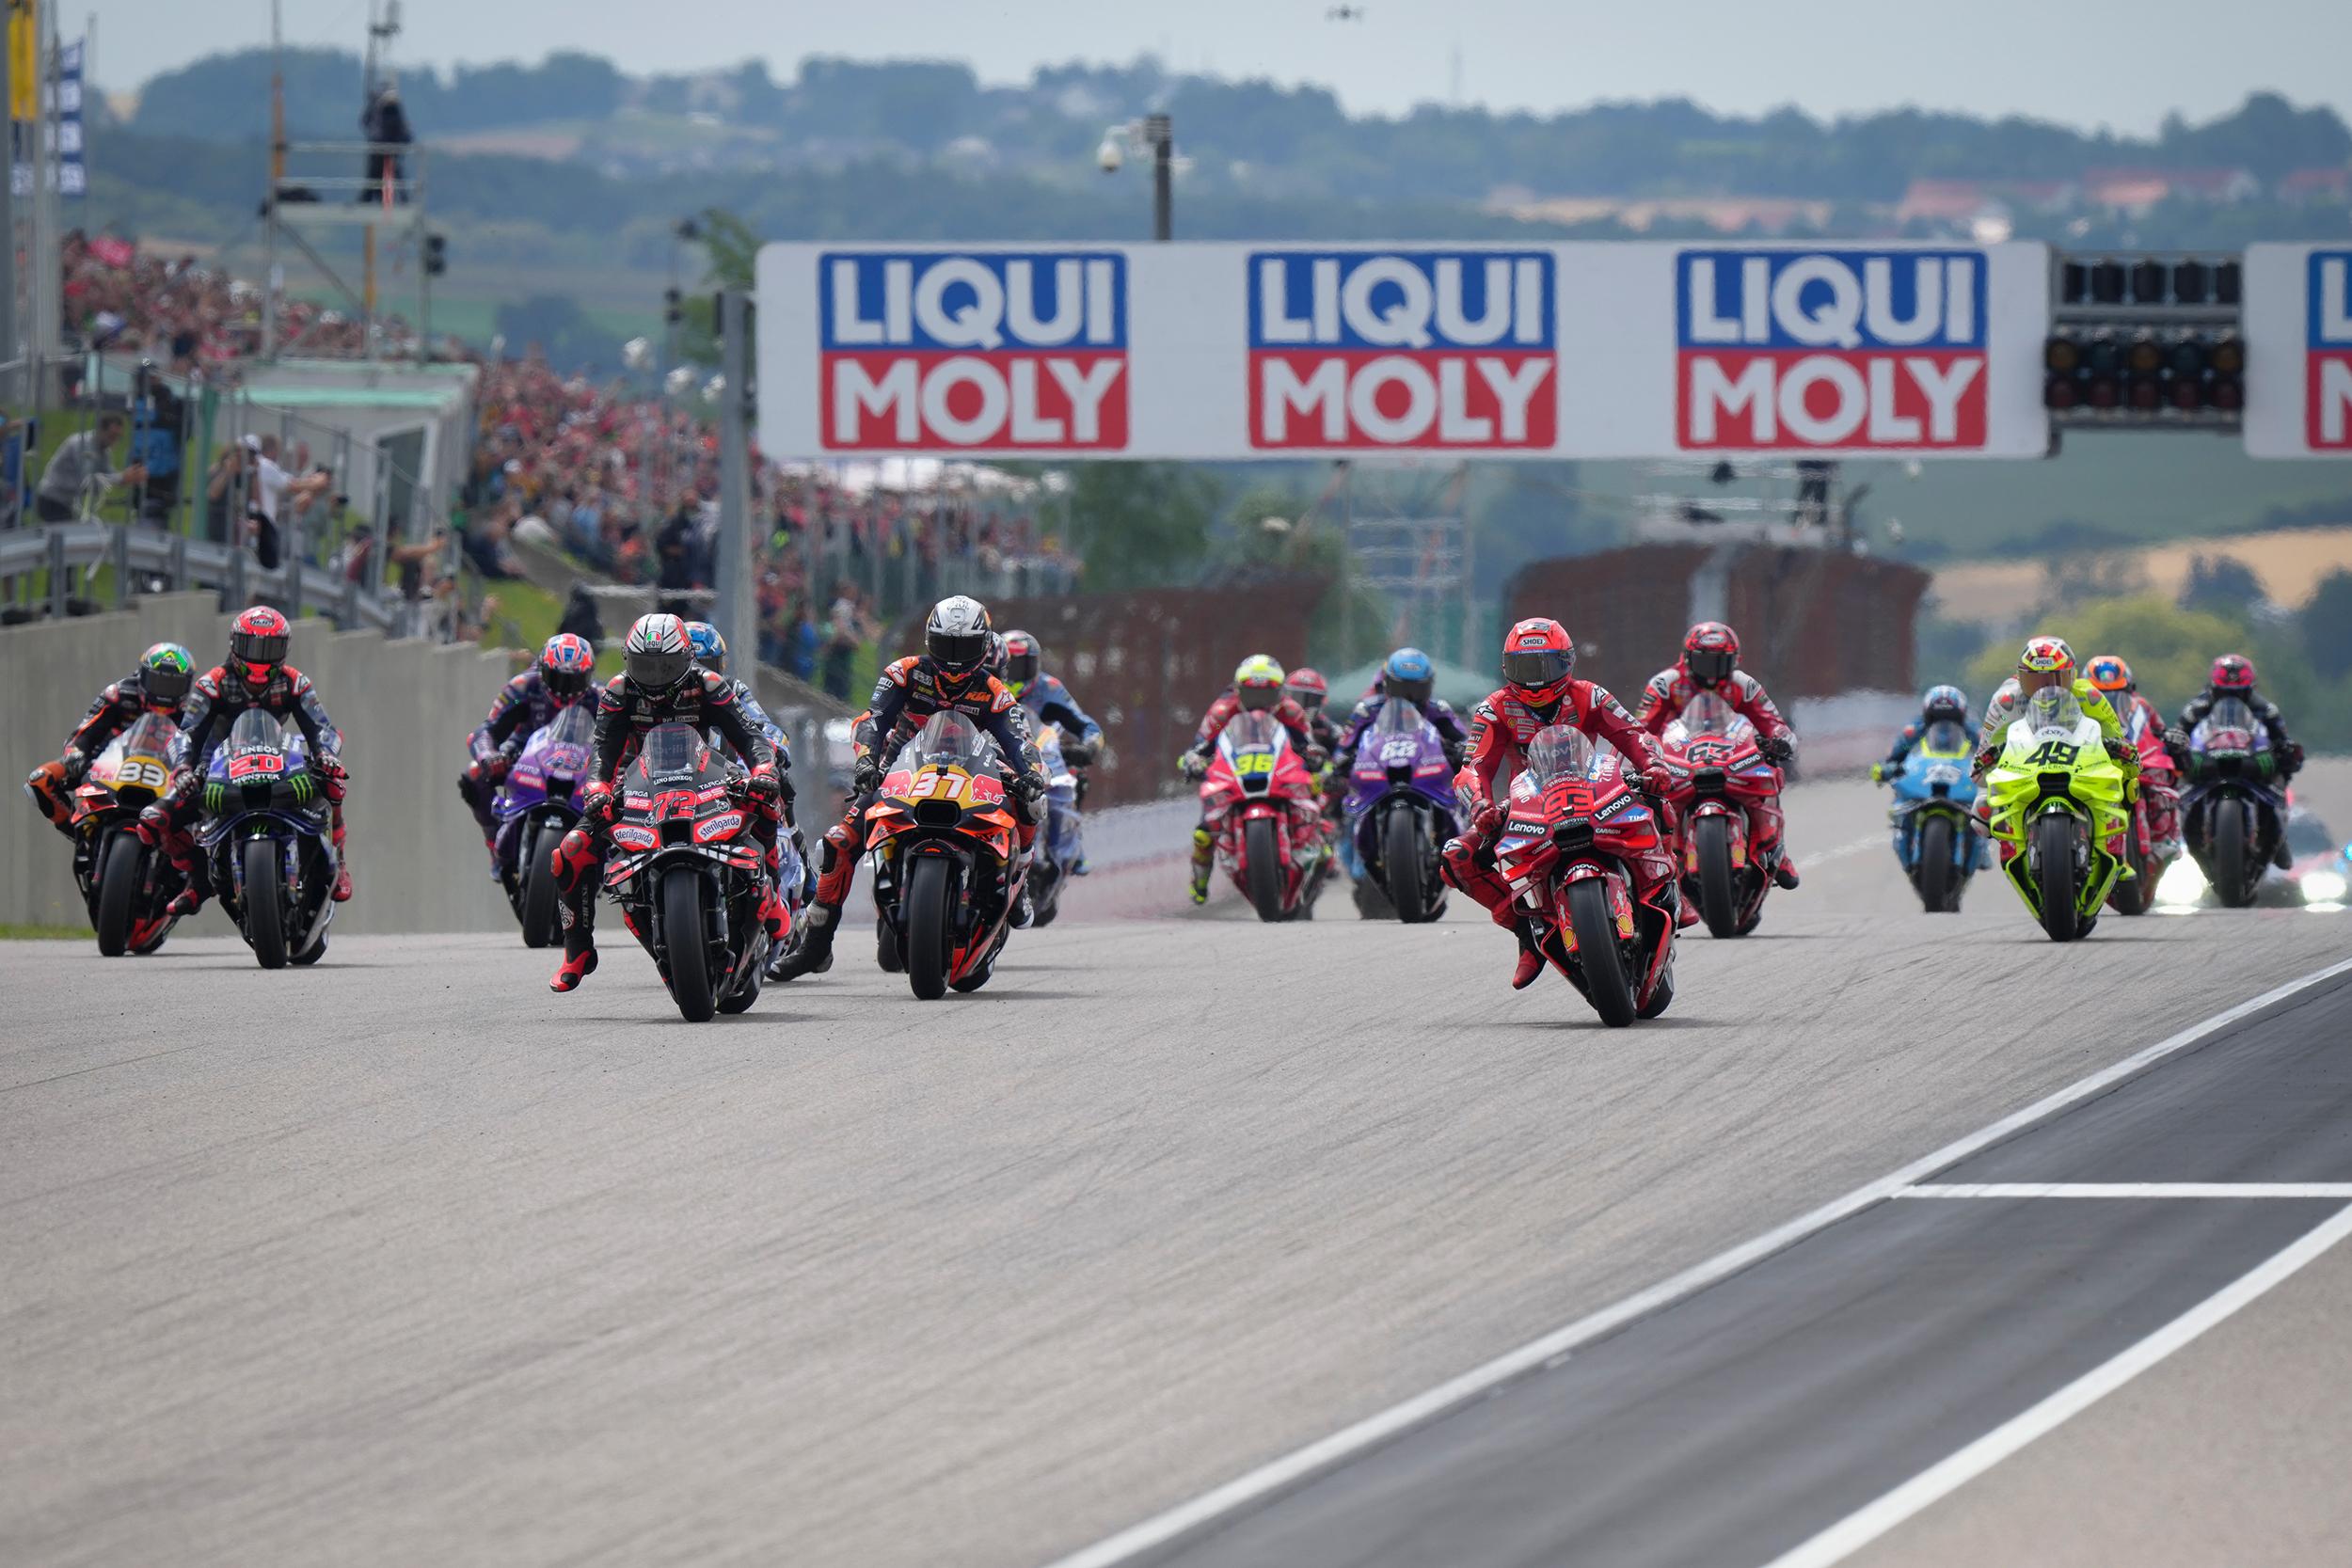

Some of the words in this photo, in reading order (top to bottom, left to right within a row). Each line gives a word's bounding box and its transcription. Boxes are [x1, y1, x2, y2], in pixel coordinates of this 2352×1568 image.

[833, 257, 1115, 350] LIQUI
[1260, 257, 1543, 350] LIQUI
[1692, 256, 1974, 349] LIQUI
[833, 356, 1123, 444] MOLY
[1260, 356, 1553, 443] MOLY
[1691, 356, 1983, 443] MOLY
[240, 745, 279, 754] ENEOS
[1728, 754, 1761, 771] Lenovo
[2024, 740, 2081, 767] 49
[117, 761, 167, 787] 33
[229, 753, 284, 780] 20
[698, 779, 726, 790] TARGA
[909, 771, 970, 800] 37
[653, 788, 697, 824] 72
[1543, 785, 1597, 822] 93
[1594, 795, 1631, 821] Lenovo
[614, 829, 654, 845] sterilgarda
[700, 816, 740, 837] sterilgarda
[1508, 821, 1546, 835] Lenovo
